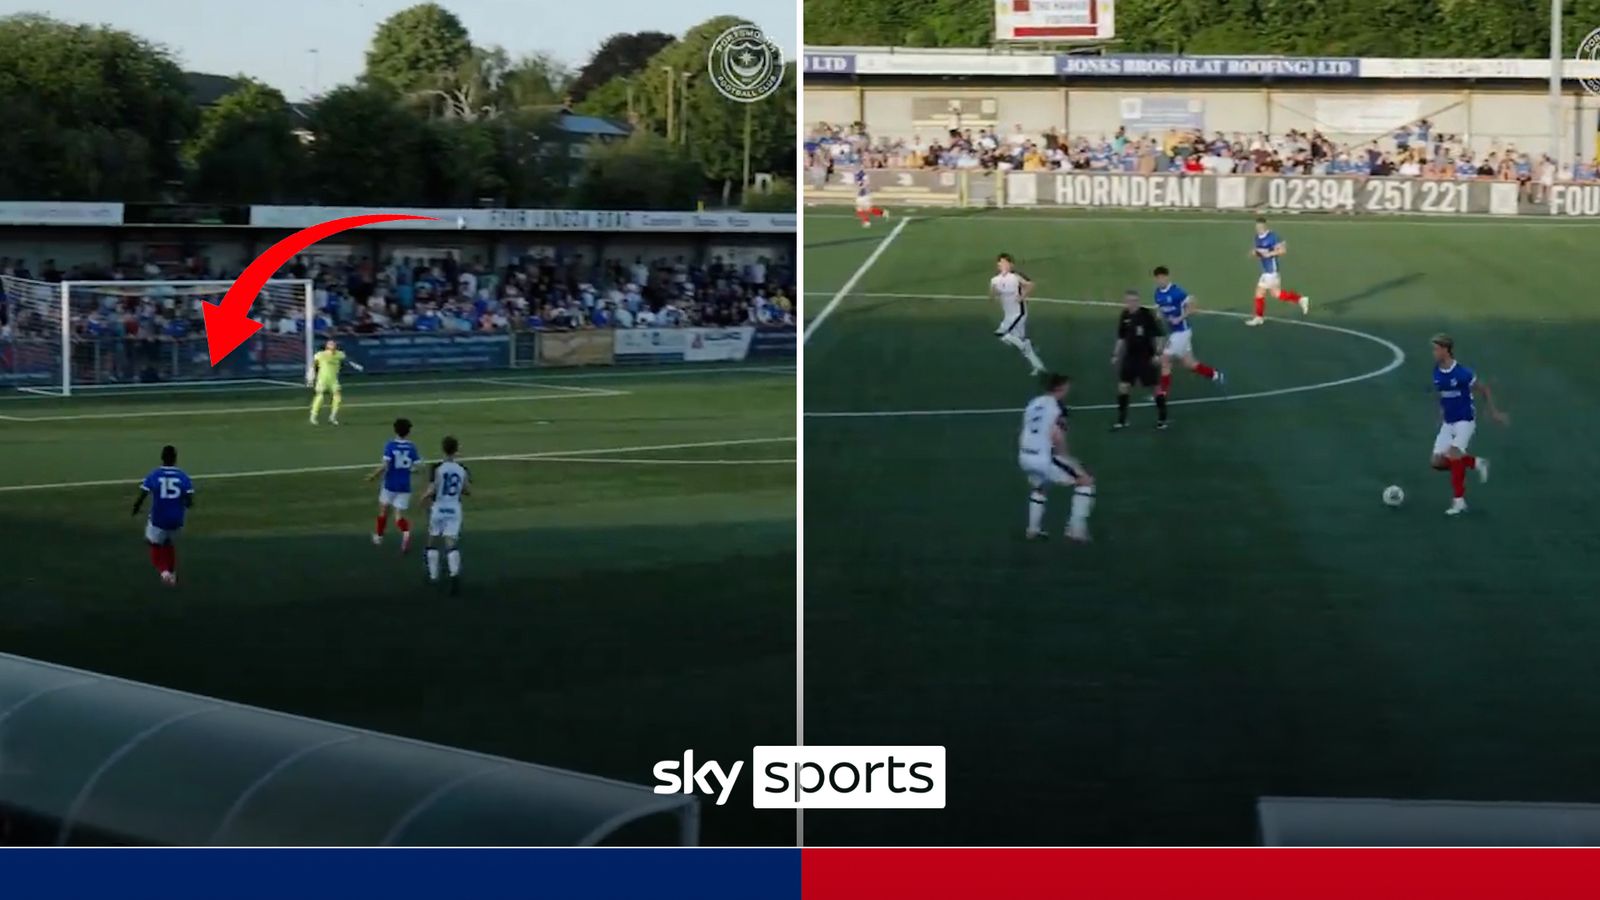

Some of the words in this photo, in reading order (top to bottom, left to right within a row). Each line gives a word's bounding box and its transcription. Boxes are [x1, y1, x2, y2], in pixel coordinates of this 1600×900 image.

[812, 57, 848, 71] LTD
[1062, 59, 1121, 74] JONES
[1123, 60, 1171, 75] BROS
[1173, 60, 1223, 75] (FLAT
[1227, 60, 1315, 76] ROOFING)
[1317, 61, 1352, 76] LTD
[1055, 174, 1201, 207] HORNDEAN
[1269, 178, 1355, 210] 02394
[1366, 180, 1413, 210] 251
[1420, 182, 1469, 213] 221
[392, 450, 412, 469] 16
[158, 476, 181, 499] 15
[442, 473, 461, 496] 18
